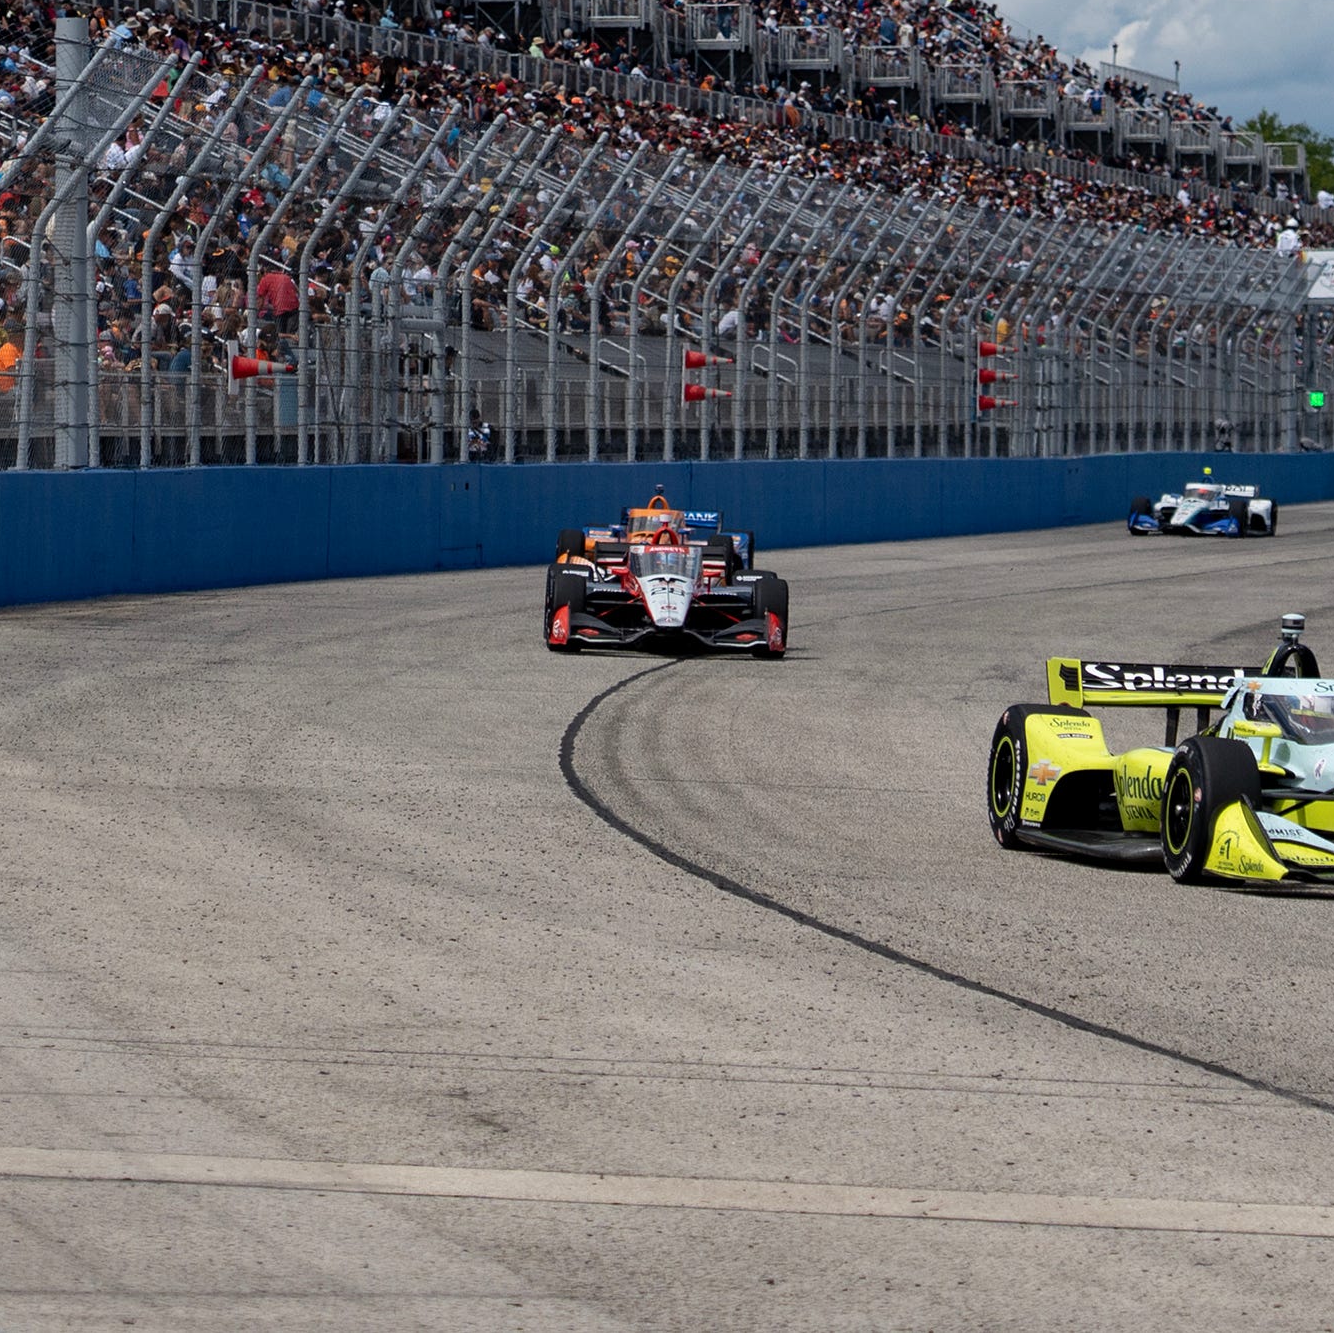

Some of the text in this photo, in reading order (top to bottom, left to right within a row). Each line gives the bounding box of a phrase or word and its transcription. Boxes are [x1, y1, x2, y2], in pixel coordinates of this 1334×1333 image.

[1083, 664, 1245, 691] Splend
[1050, 717, 1091, 728] Splenda
[1269, 828, 1303, 837] OMISE
